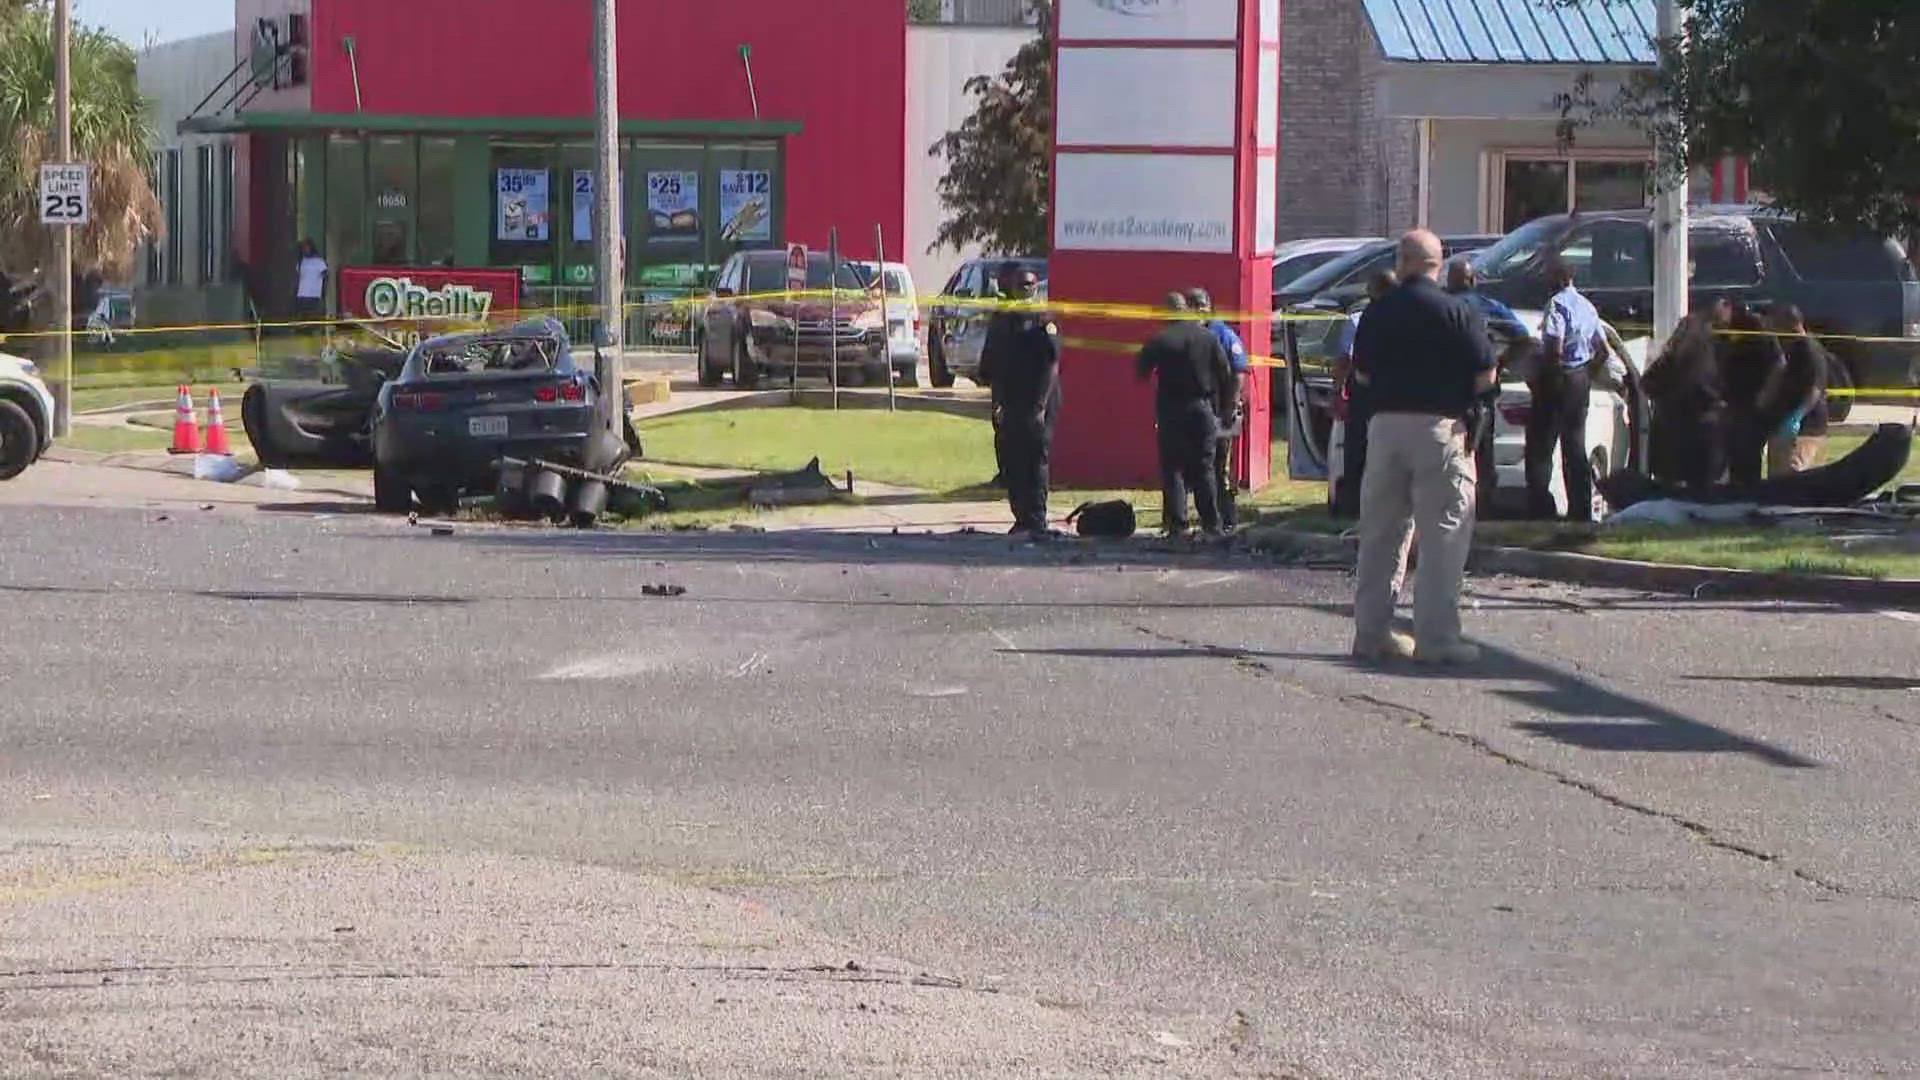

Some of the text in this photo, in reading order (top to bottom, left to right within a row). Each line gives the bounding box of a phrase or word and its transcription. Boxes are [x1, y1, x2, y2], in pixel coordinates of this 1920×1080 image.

[44, 169, 83, 180] SPEED
[48, 181, 80, 192] LIMIT
[651, 176, 681, 194] $25
[45, 195, 83, 217] 25
[366, 277, 493, 321] O'Reilly
